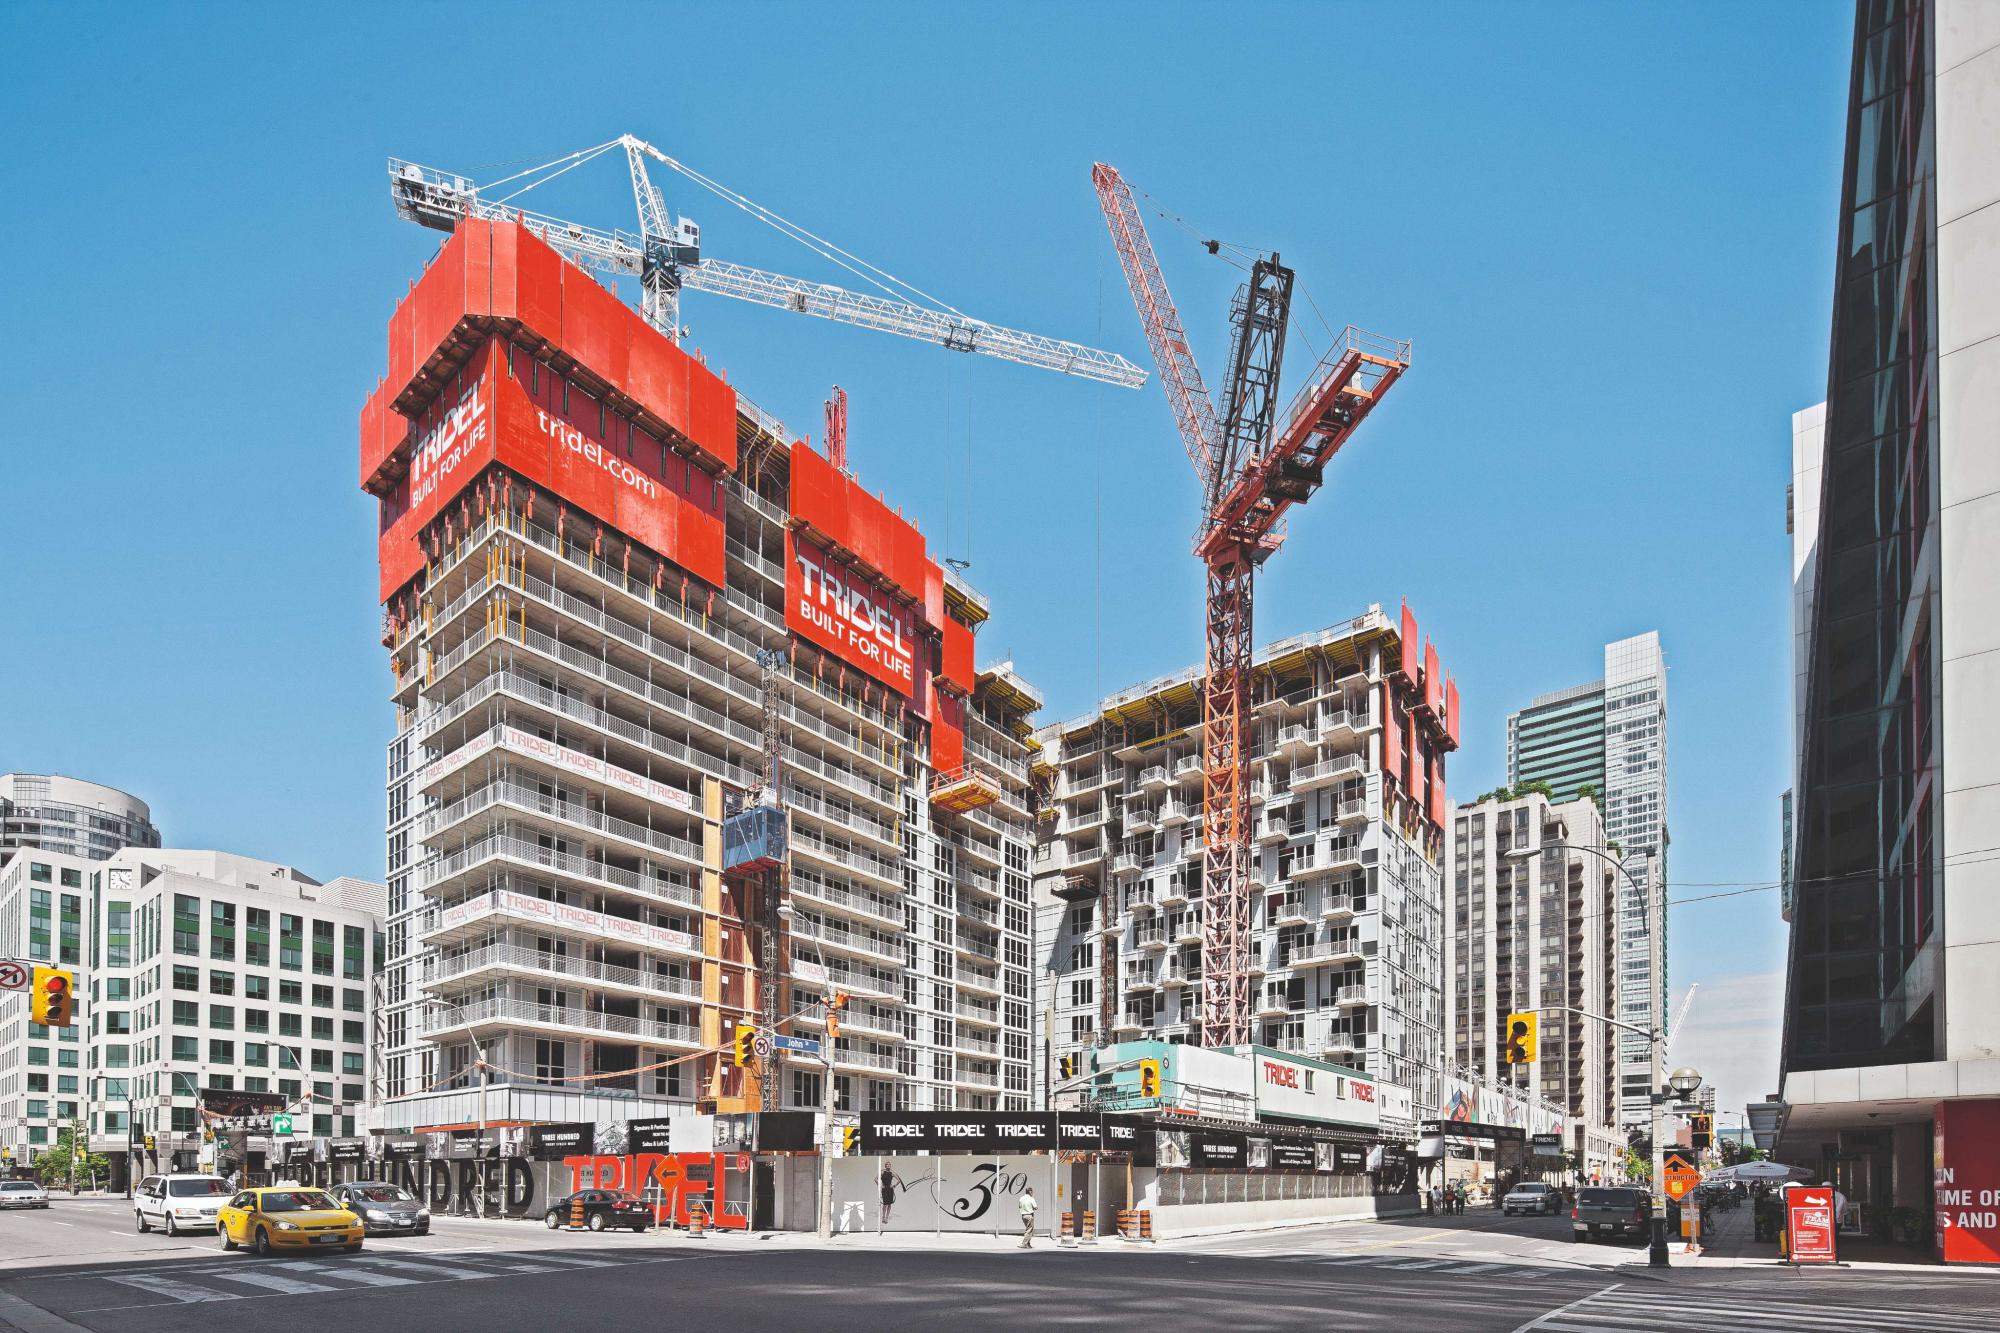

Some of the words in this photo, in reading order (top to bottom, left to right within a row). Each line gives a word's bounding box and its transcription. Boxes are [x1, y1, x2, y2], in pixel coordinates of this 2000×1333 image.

[411, 381, 485, 481] TRIDEL
[538, 410, 655, 500] tridel.com
[412, 471, 438, 508] BUILT
[440, 447, 460, 480] FOR
[464, 419, 486, 456] LIFE
[798, 555, 911, 658] TRIDEL
[800, 599, 844, 640] BUILT
[849, 630, 879, 663] FOR
[884, 651, 911, 680] LIFE
[509, 731, 554, 756] TRIDEL
[559, 749, 601, 773] TRIDEL
[607, 766, 646, 789] TRIDEL
[651, 783, 688, 804] TRIDEL
[507, 895, 551, 915] TRIDEL
[558, 906, 600, 927] TRIDEL
[606, 919, 644, 936] TRIDEL
[650, 929, 687, 945] TRIDEL
[787, 1038, 803, 1048] John
[1264, 1062, 1298, 1089] TRIDEL
[1350, 1081, 1375, 1103] TRIDEL
[557, 1133, 580, 1141] HUNDRED
[873, 1125, 924, 1137] TRIDEL
[935, 1125, 985, 1137] TRIDEL
[996, 1125, 1045, 1137] TRIDEL
[1061, 1125, 1099, 1137] TRIDEL
[1110, 1126, 1135, 1138] TRIDEL
[1203, 1144, 1216, 1152] THREE
[1217, 1145, 1237, 1153] HUNDRED
[564, 1152, 747, 1229] TRIDEL
[953, 1163, 1028, 1222] 300
[1957, 1211, 1997, 1228] AND
